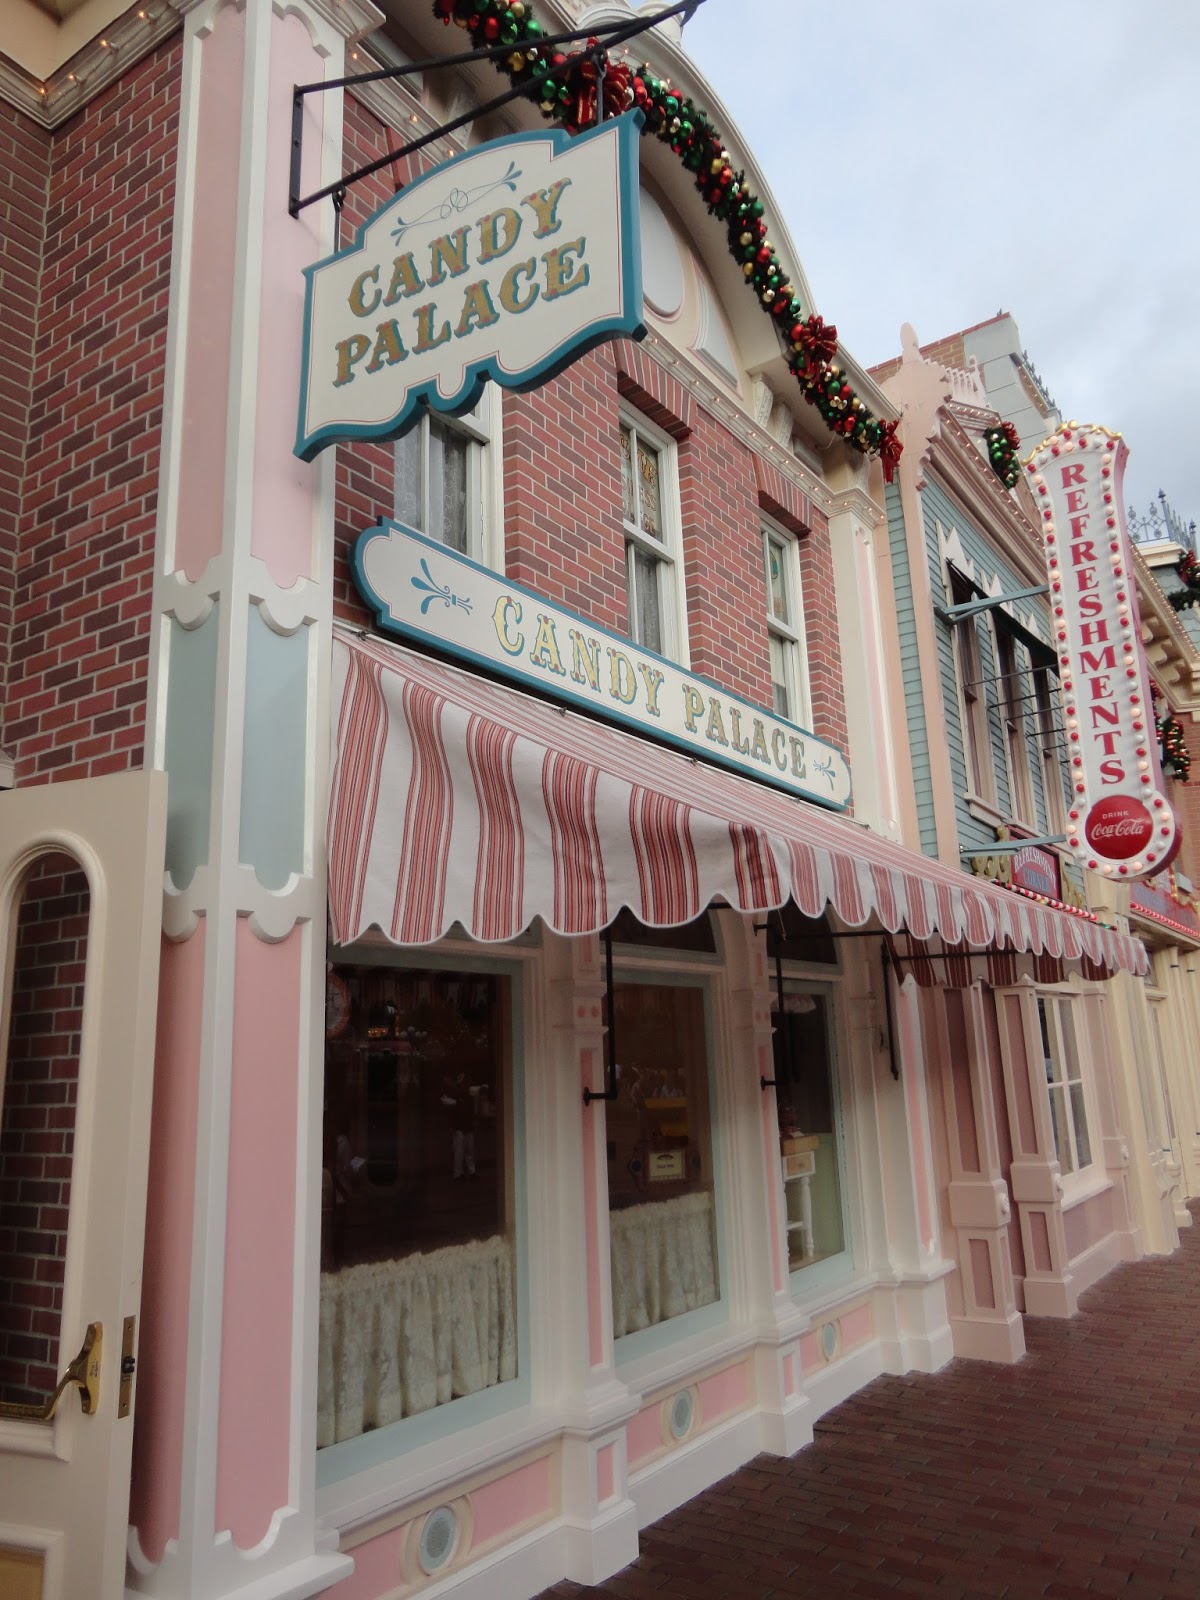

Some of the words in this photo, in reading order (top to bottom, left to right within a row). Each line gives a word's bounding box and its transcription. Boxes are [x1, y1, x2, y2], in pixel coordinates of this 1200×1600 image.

[332, 236, 590, 388] PALACE
[348, 177, 572, 317] CANDY
[492, 595, 665, 717] CANDY
[684, 684, 807, 780] PALACE
[1061, 463, 1126, 784] REFRESHMENTS
[1090, 818, 1145, 841] Coca-Cola
[1102, 810, 1130, 820] DRINK
